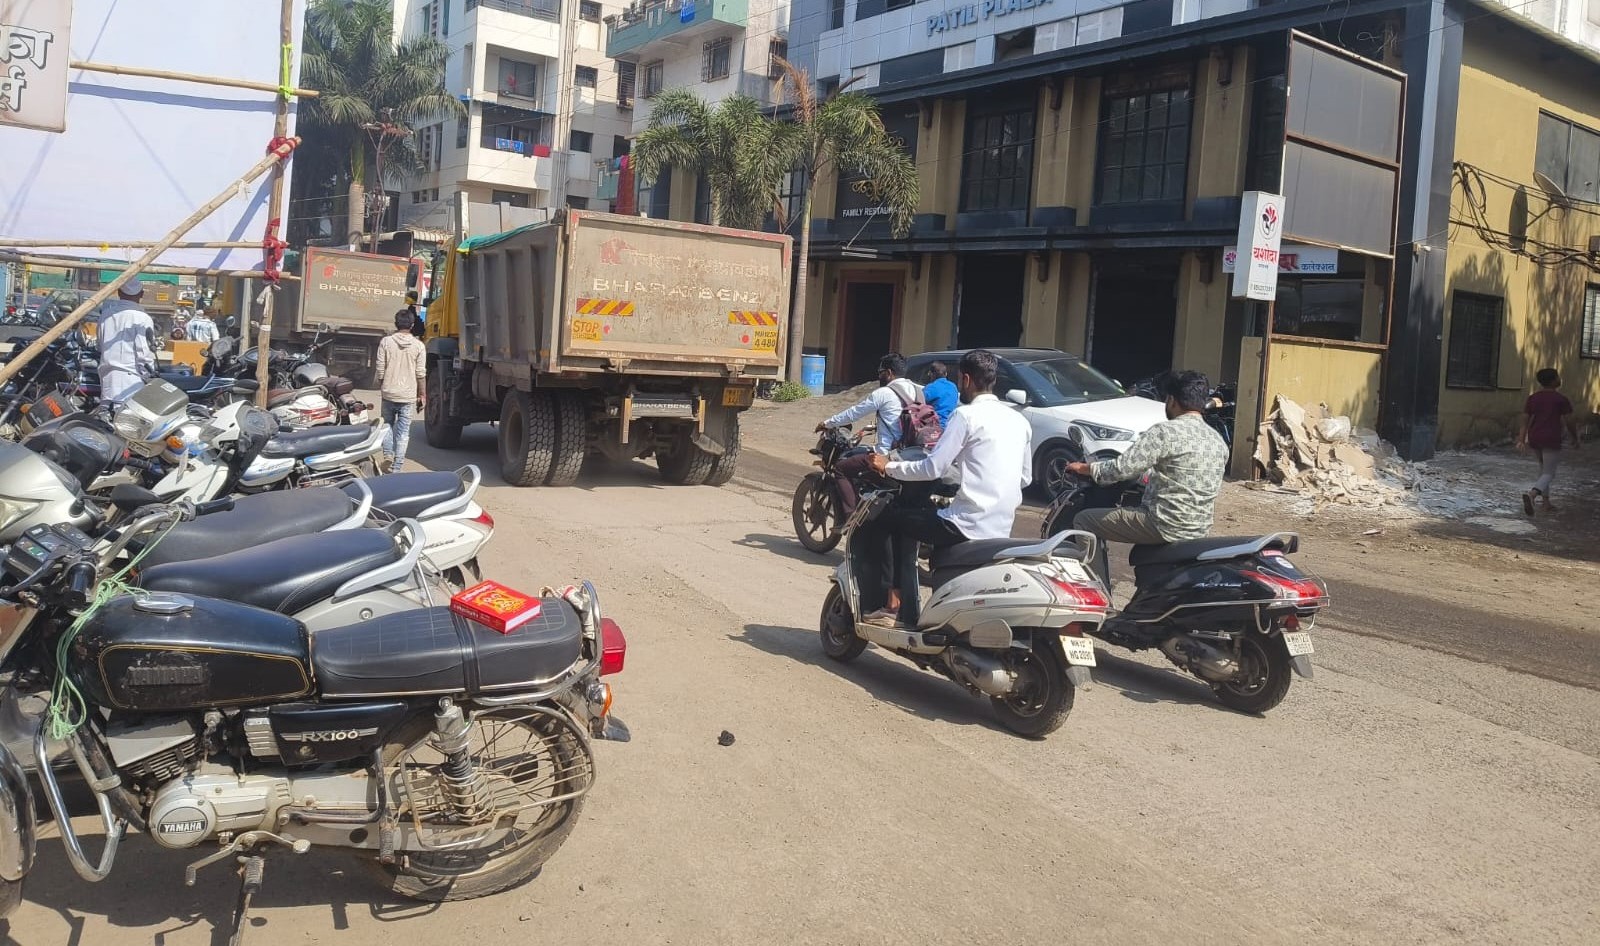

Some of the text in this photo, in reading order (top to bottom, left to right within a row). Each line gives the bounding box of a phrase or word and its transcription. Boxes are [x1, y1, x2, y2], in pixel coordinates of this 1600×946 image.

[927, 0, 1054, 37] PATIL PLAZ
[842, 207, 863, 218] FAMILY
[1301, 260, 1336, 272] कलेक्शन
[572, 320, 600, 334] STOP
[301, 730, 359, 742] RX100
[164, 822, 202, 833] YAMAHA
